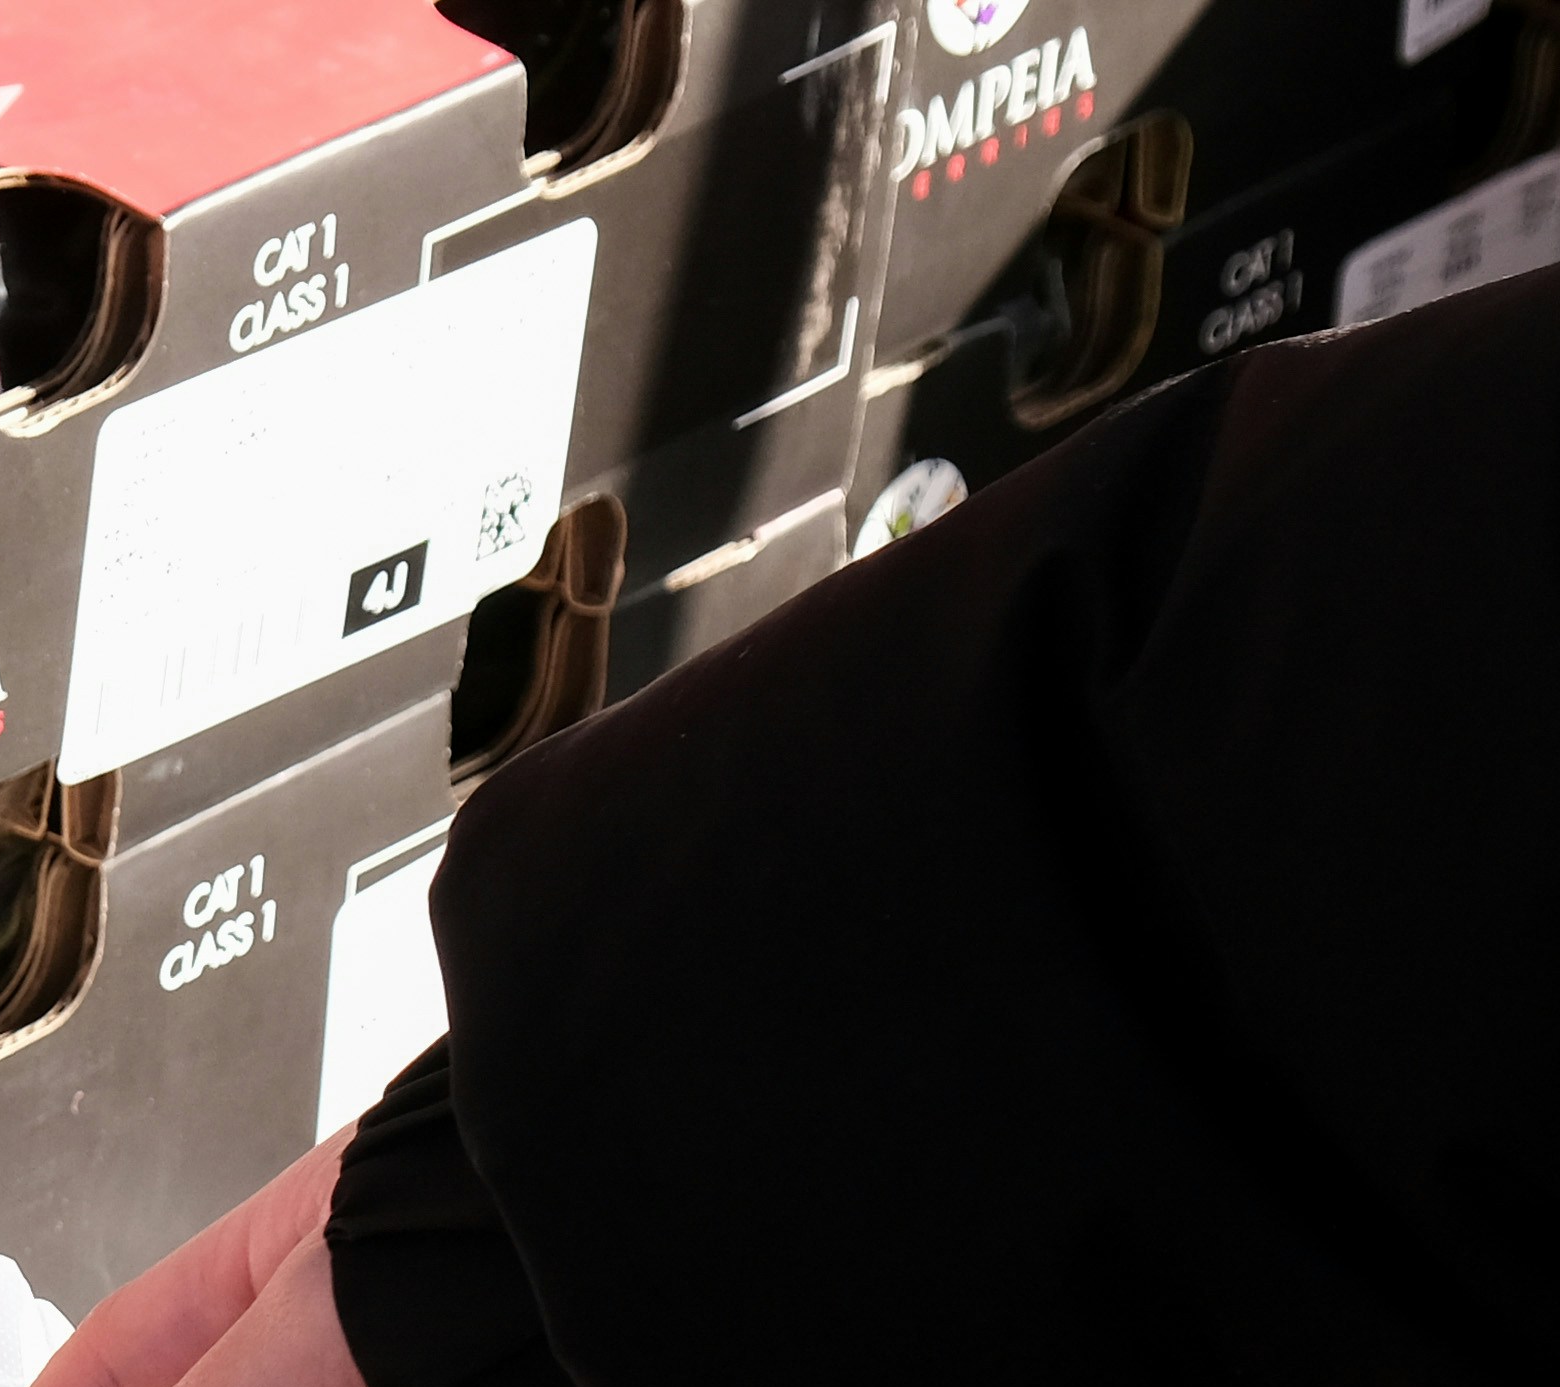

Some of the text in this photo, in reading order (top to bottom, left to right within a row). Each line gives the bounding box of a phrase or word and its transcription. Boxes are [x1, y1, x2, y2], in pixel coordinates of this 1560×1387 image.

[890, 26, 1097, 182] OMPEIA
[253, 212, 337, 287] CAT 1
[1220, 237, 1278, 297] CAT
[229, 262, 350, 353] CLASS 1
[183, 854, 265, 929] CAT 1
[159, 899, 277, 991] CLASS 1
